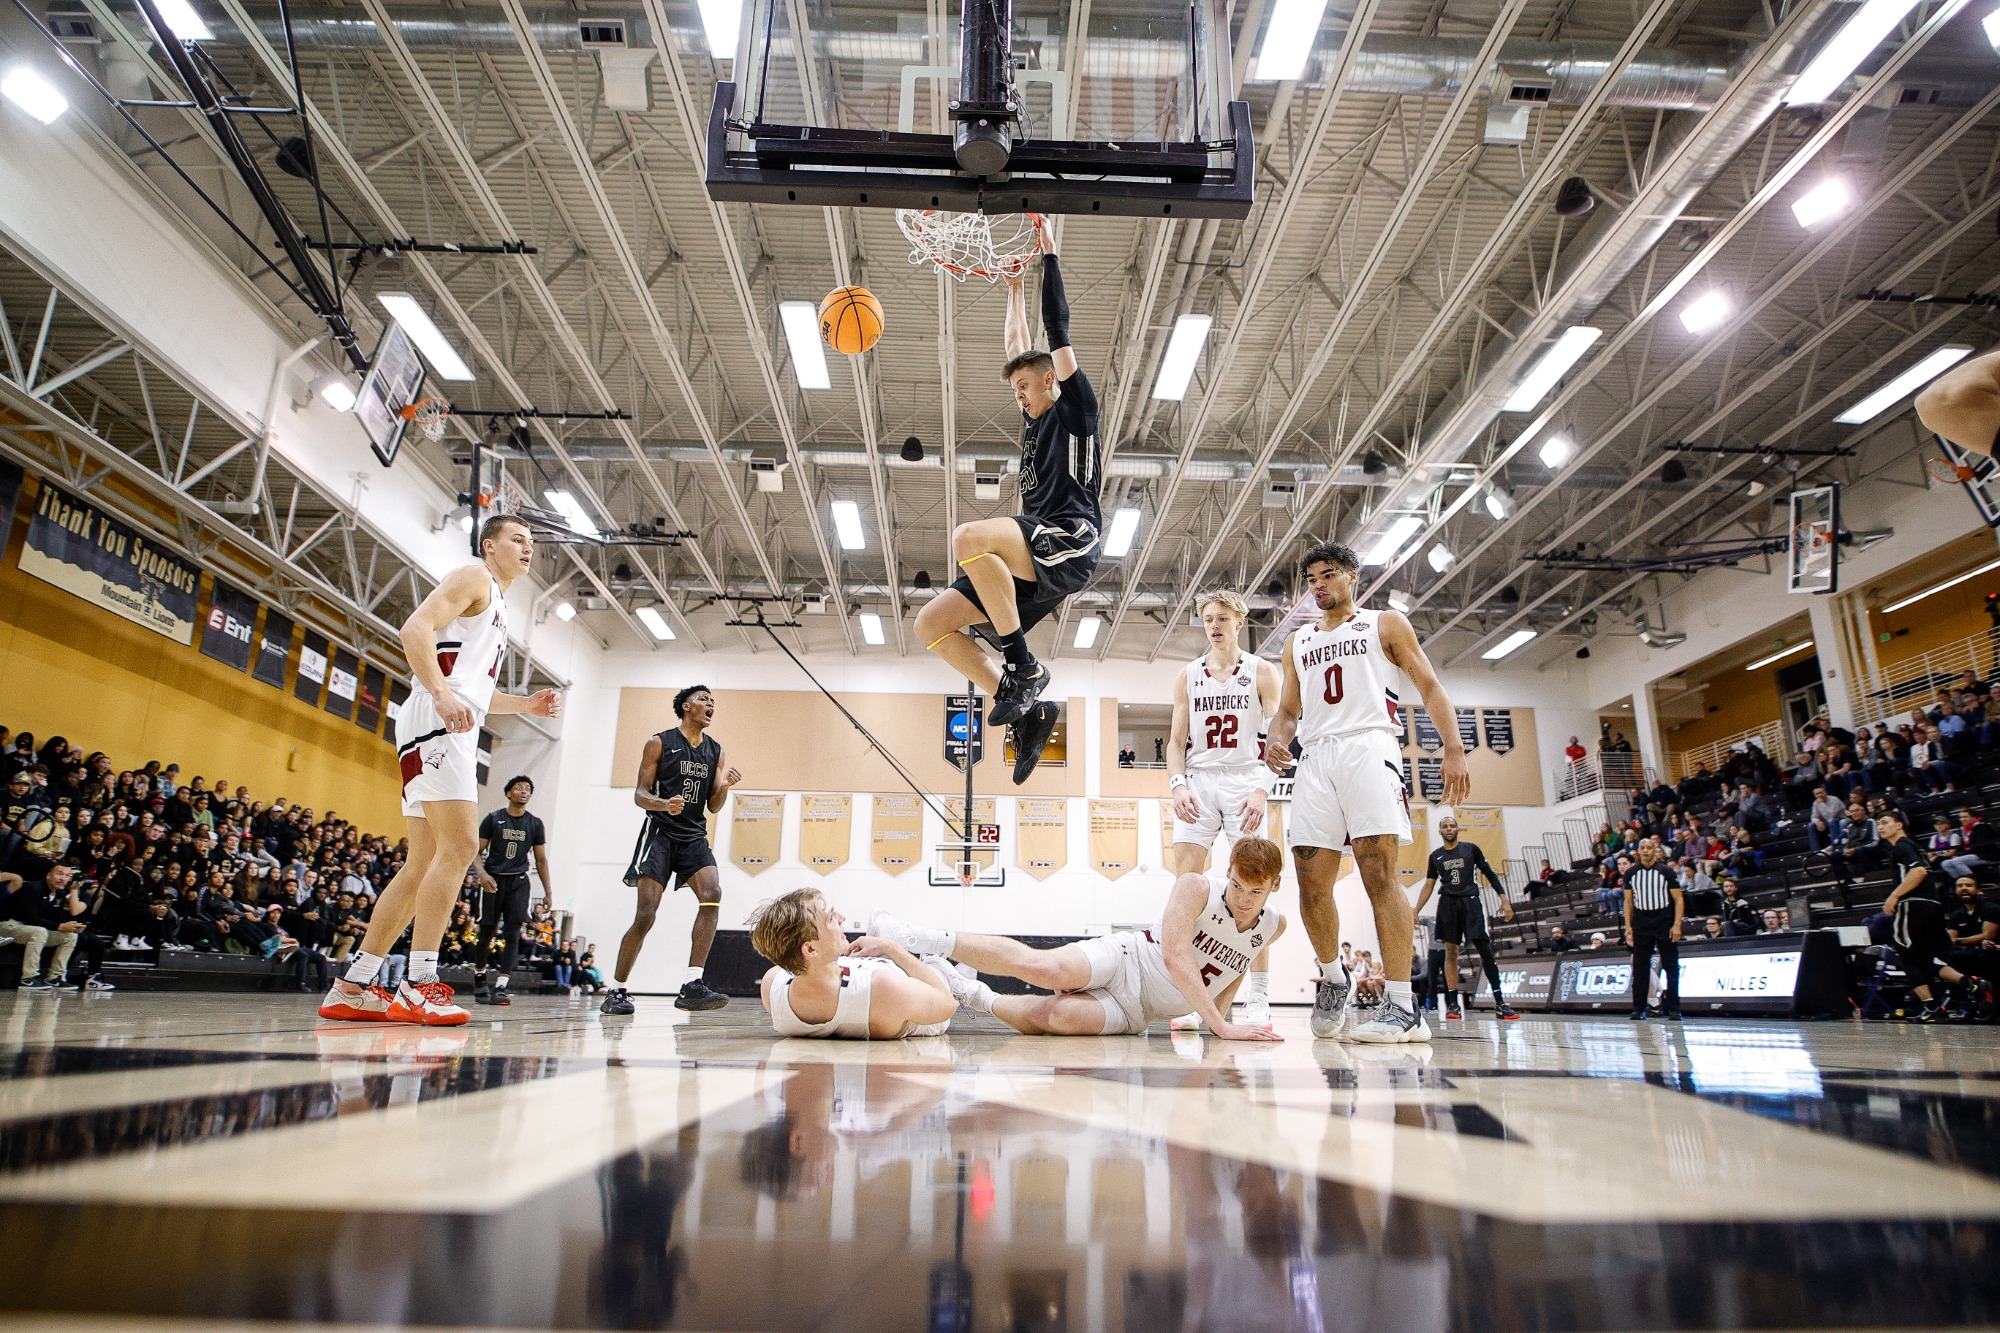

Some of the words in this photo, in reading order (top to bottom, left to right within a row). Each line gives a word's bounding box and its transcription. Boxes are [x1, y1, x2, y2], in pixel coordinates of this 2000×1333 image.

[38, 484, 93, 539] Thank
[97, 517, 127, 557] You
[130, 537, 195, 594] Sponsors
[101, 584, 141, 612] Mountain
[153, 609, 175, 627] Lions
[223, 614, 253, 643] Ent
[1301, 639, 1367, 671] MAVERICKS
[1324, 664, 1344, 705] 0
[1194, 694, 1250, 712] MAVERICKS
[953, 725, 977, 733] NCA
[1205, 715, 1238, 749] 22
[680, 760, 709, 778] UCCS
[682, 778, 701, 803] 21
[502, 828, 526, 841] UCCS
[980, 827, 998, 842] 22
[506, 842, 518, 859] 0
[1451, 869, 1460, 885] 3
[1192, 930, 1251, 974] MAVERICKS
[1576, 964, 1632, 995] UCCS
[1716, 977, 1768, 990] NILLES
